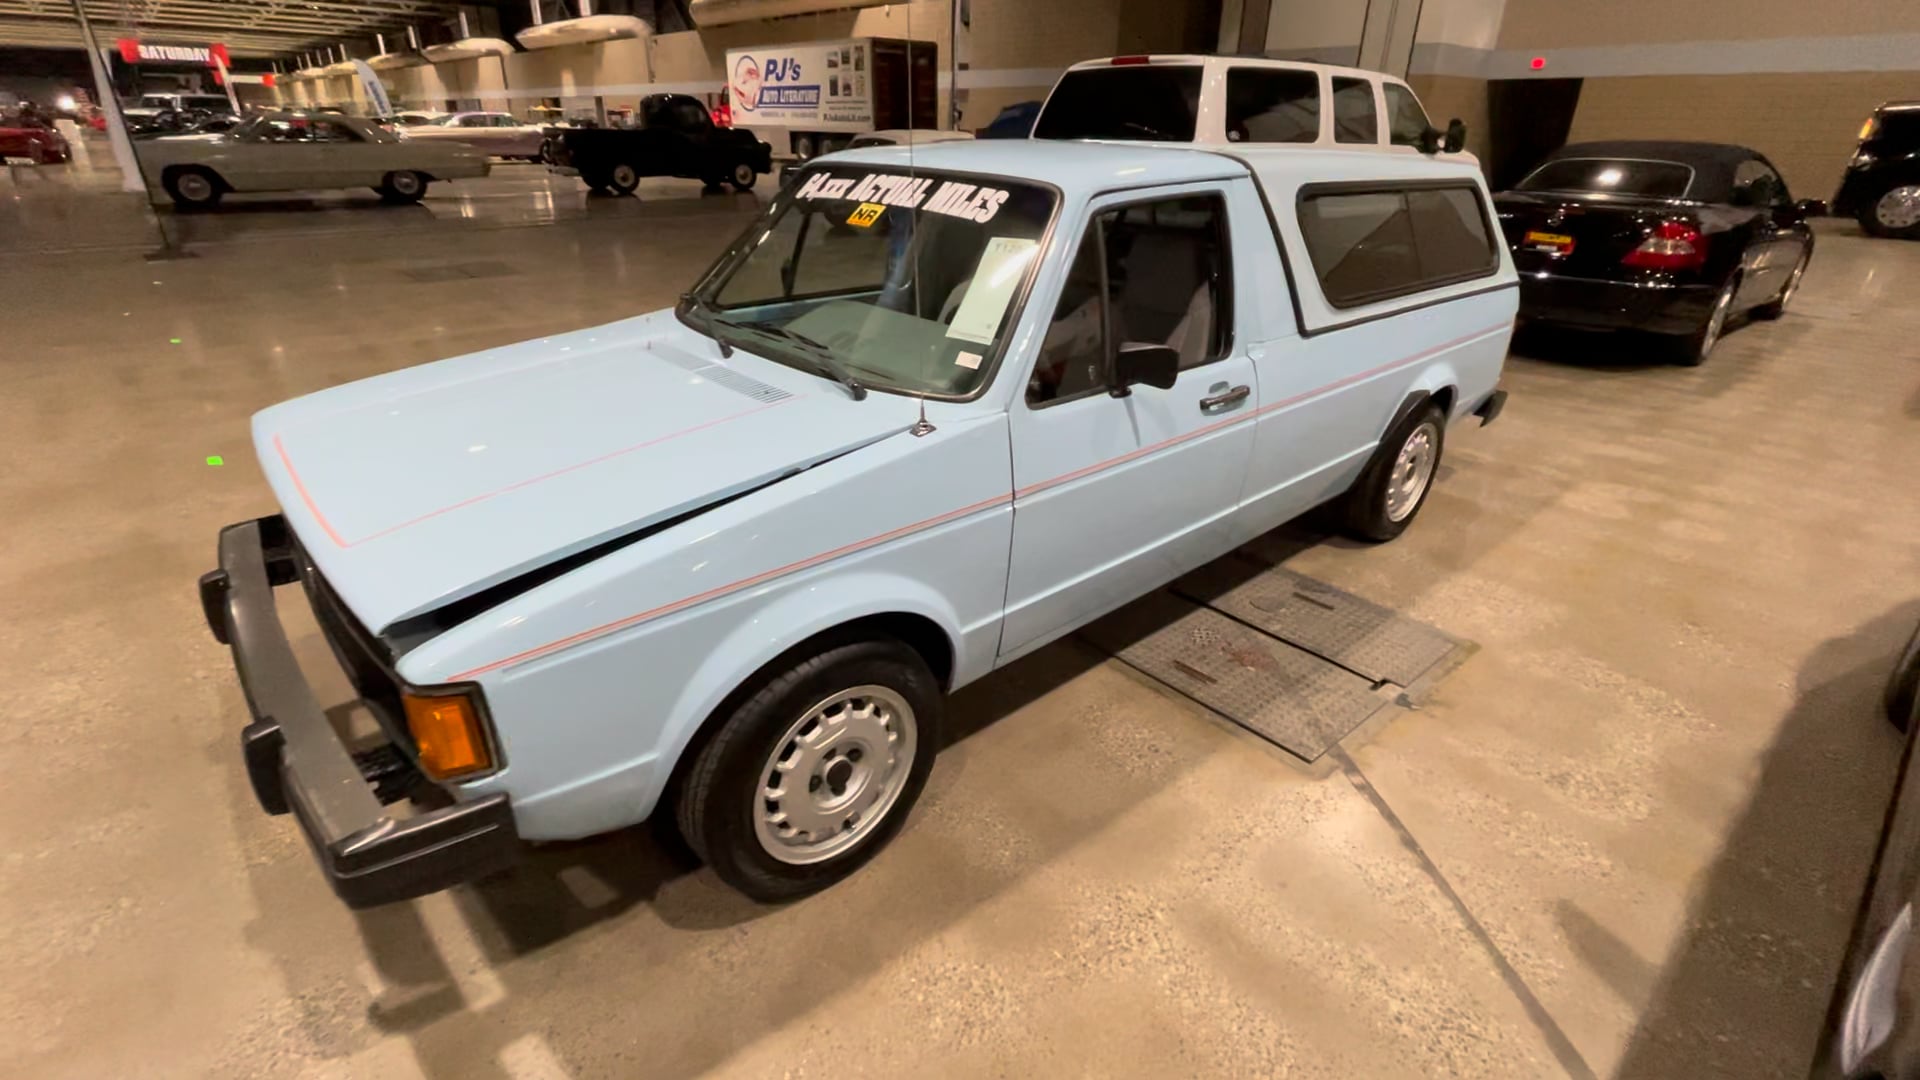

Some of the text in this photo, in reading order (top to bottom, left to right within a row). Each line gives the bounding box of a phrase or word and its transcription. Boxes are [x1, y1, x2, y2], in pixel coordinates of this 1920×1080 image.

[137, 45, 210, 61] SATURDAY
[846, 174, 933, 208] ACTUAL
[921, 181, 1010, 224] MILES
